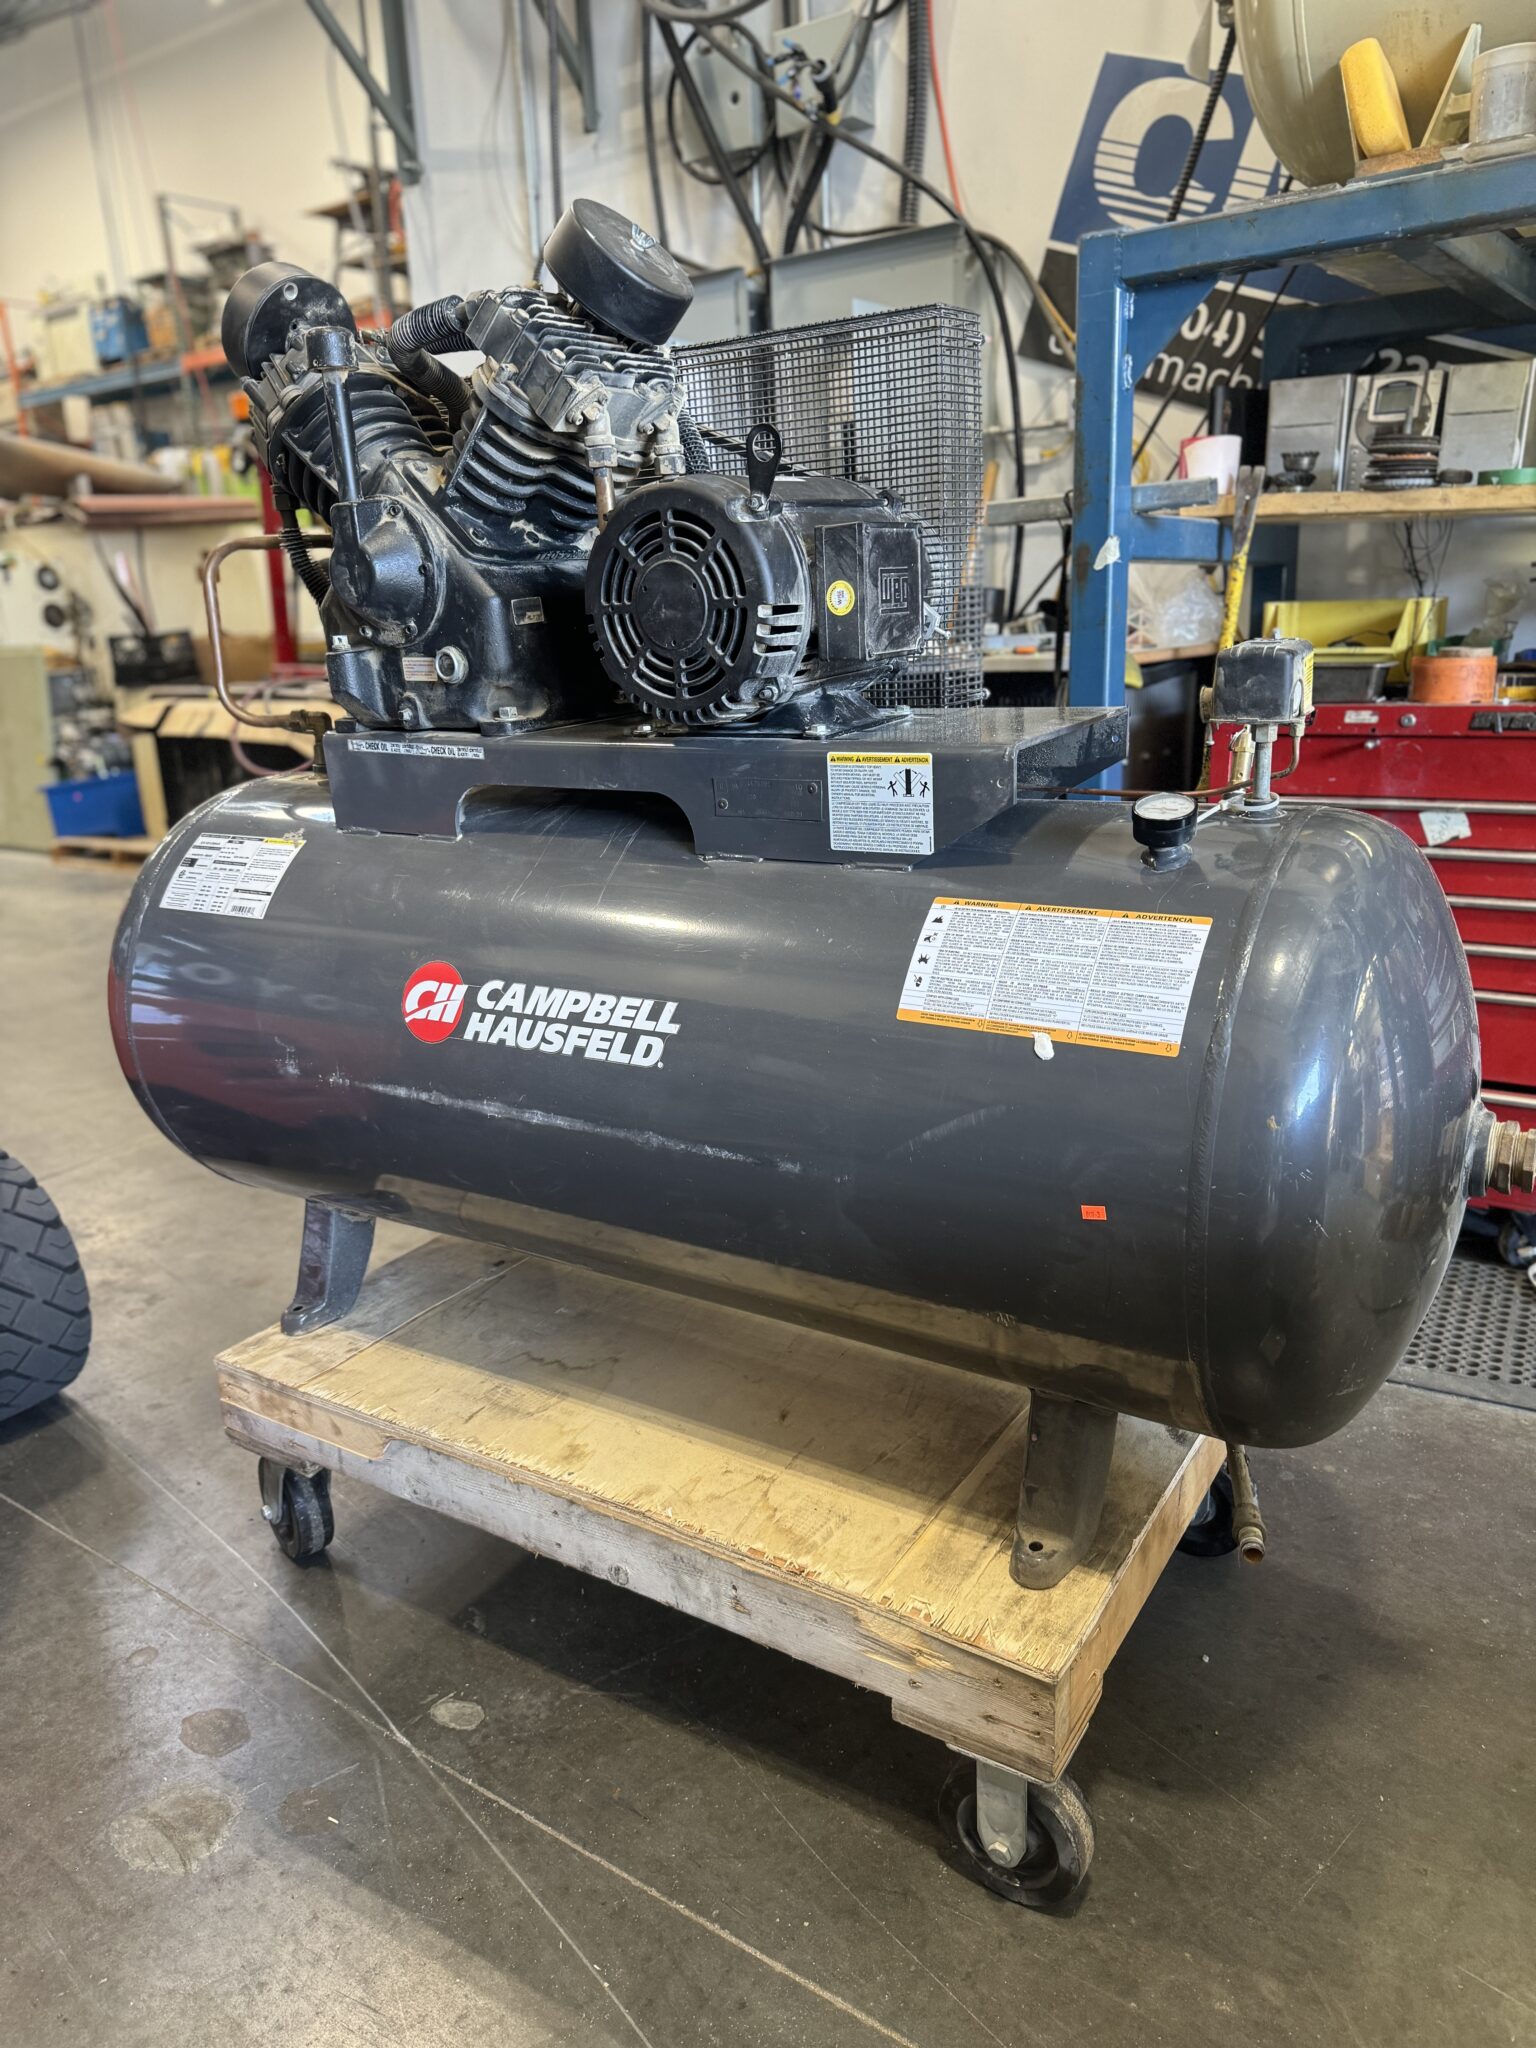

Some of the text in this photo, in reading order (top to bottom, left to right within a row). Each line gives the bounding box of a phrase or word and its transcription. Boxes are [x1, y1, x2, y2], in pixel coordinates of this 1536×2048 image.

[365, 741, 380, 751] CHECK
[381, 743, 389, 752] OIL
[431, 745, 446, 755] CHECK
[447, 747, 456, 756] OIL
[964, 900, 1193, 923] WARNING AVERTISSEMENT ADVERTENCIA
[476, 979, 681, 1034] CAMPBELL
